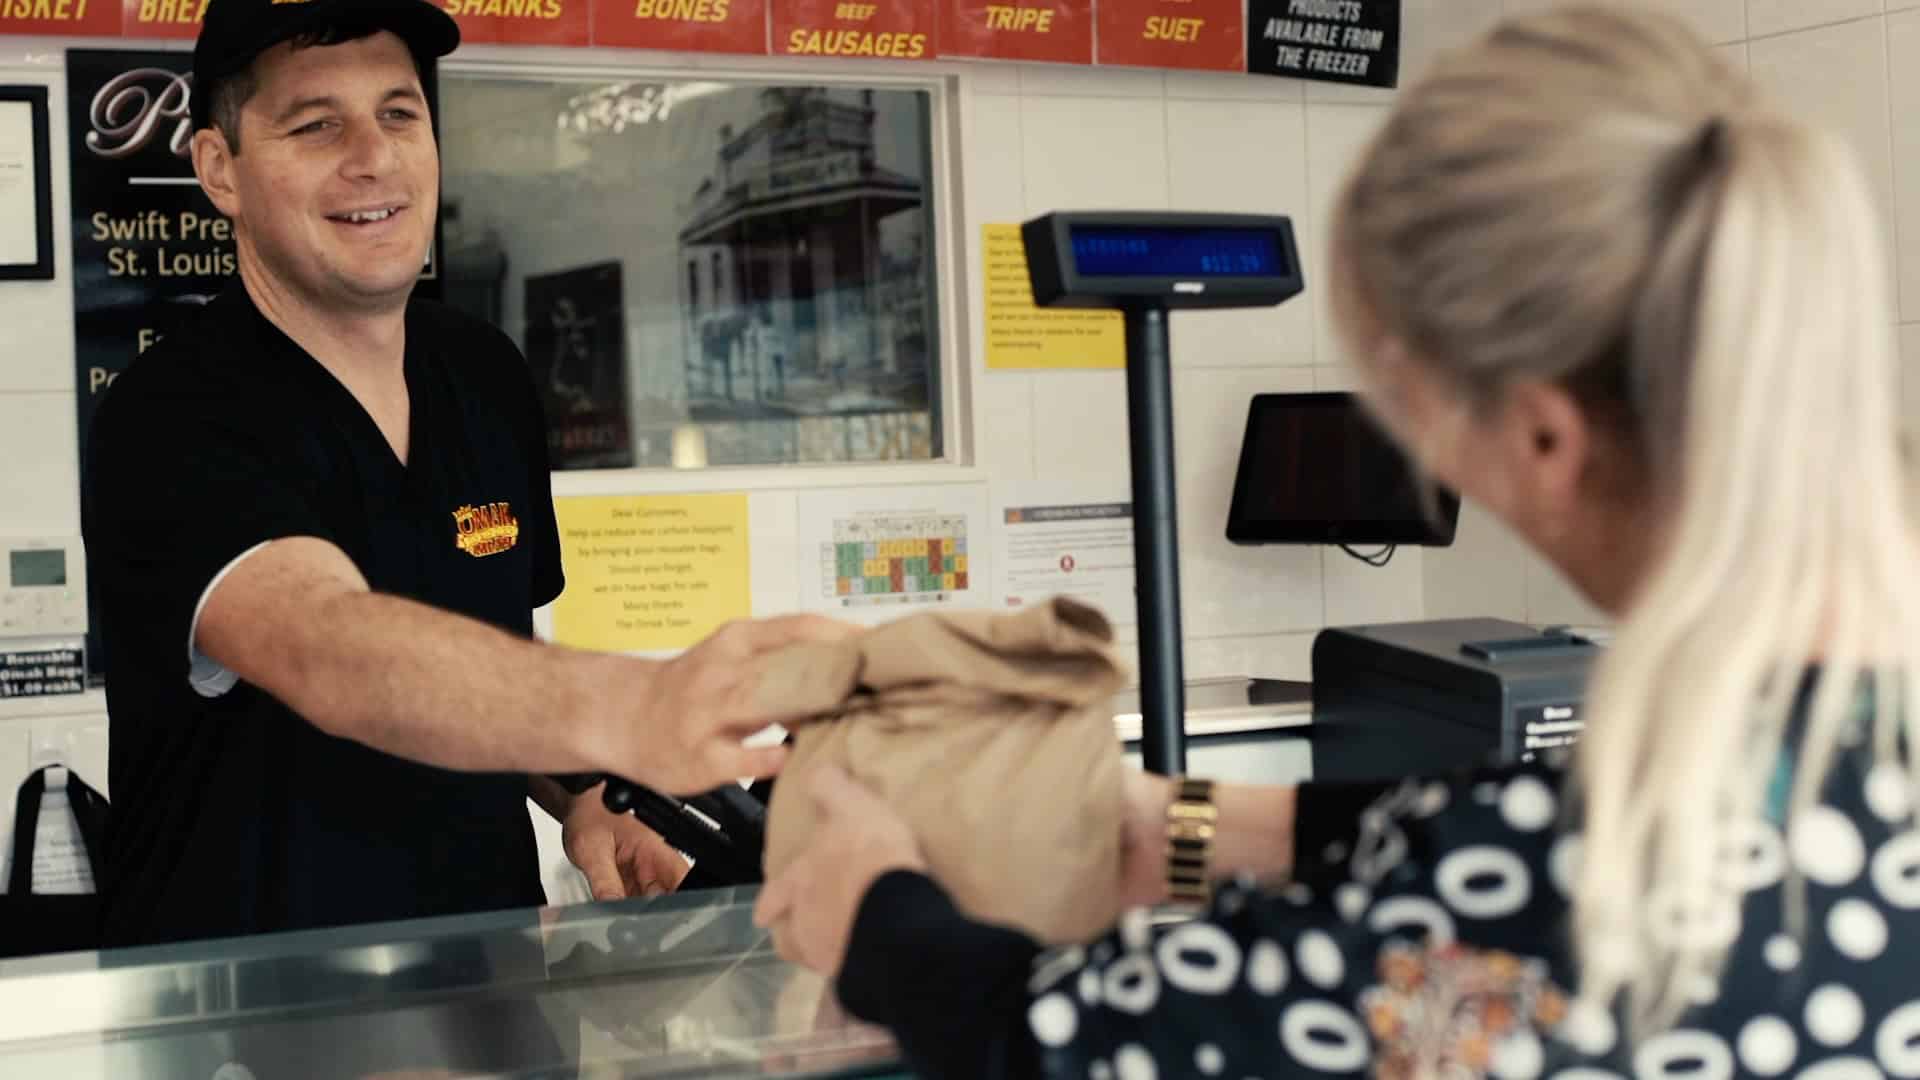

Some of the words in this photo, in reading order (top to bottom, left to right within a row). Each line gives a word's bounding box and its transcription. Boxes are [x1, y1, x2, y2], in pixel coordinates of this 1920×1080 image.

[0, 0, 87, 20] ISKET
[444, 0, 562, 19] SHANKS
[635, 0, 729, 22] BONES
[985, 5, 1055, 33] TRIPE
[1288, 0, 1362, 23] PRODUCTS
[1143, 15, 1205, 41] SUET
[1263, 18, 1341, 46] AVAILABLE
[1341, 26, 1384, 51] FROM
[788, 29, 927, 57] SAUSAGES
[1276, 45, 1304, 69] THE
[1306, 49, 1370, 76] FREEZER
[91, 210, 171, 241] Swift
[179, 211, 236, 241] Pre
[107, 247, 148, 277] St.
